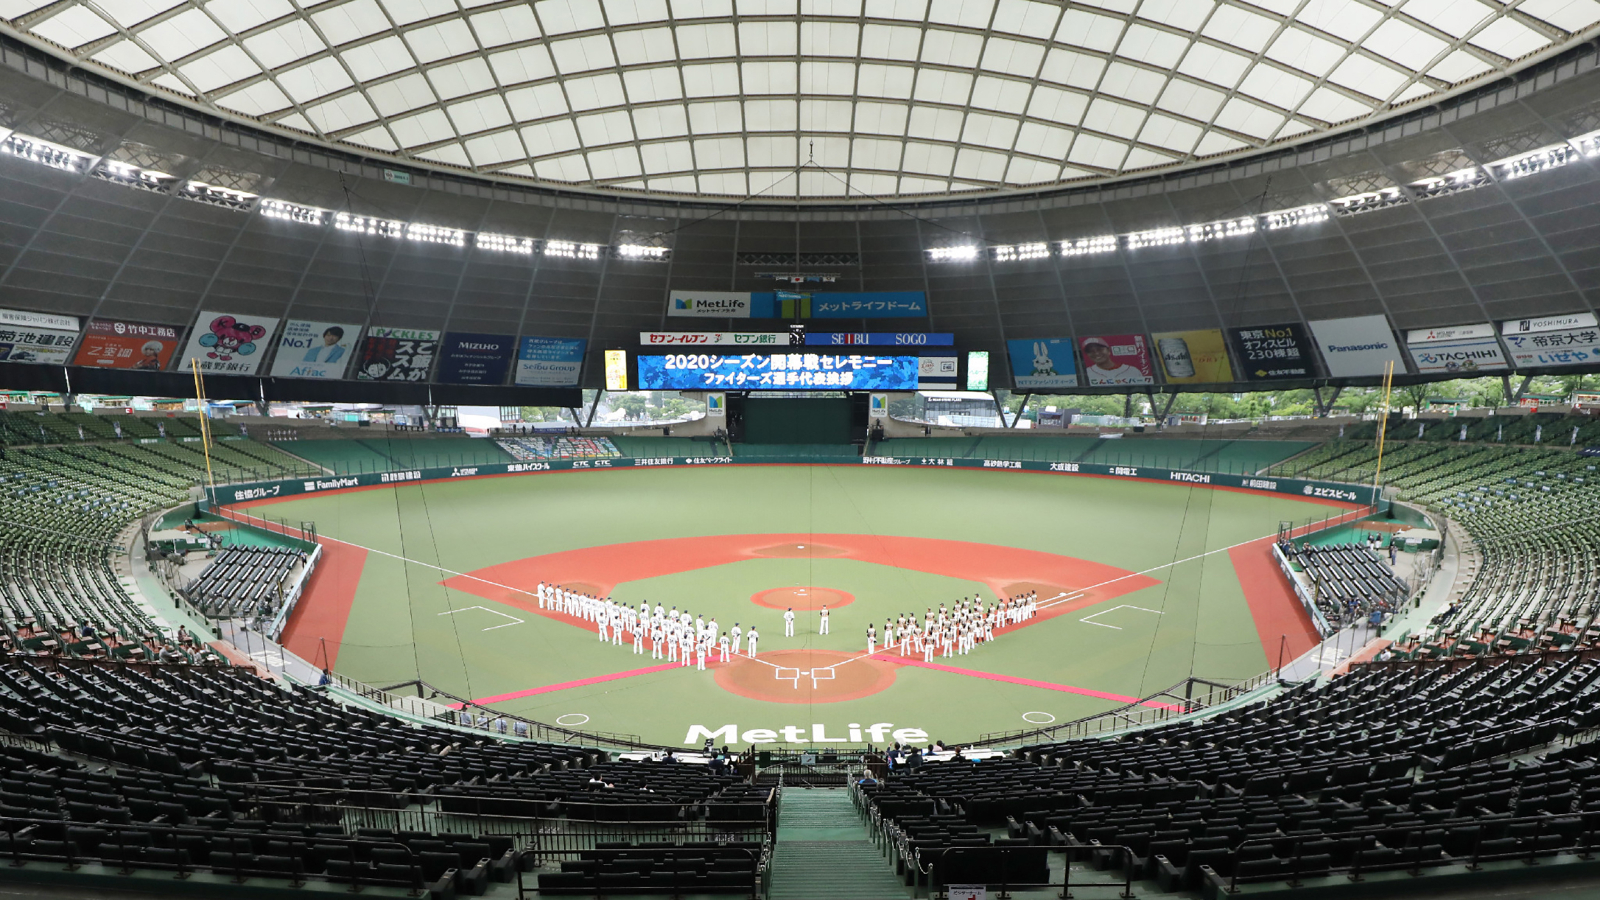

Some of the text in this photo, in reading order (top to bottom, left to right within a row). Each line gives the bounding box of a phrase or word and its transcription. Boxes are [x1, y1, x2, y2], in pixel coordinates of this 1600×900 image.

[696, 300, 745, 308] MetLife
[819, 301, 921, 311] メットライフドーム
[1533, 318, 1579, 327] YOSHIMURA
[128, 324, 175, 337] 竹中工務店
[282, 337, 313, 349] No.1
[734, 333, 776, 343] セブン銀行
[831, 333, 869, 345] SEIBU
[895, 333, 927, 345] SOGO
[1243, 338, 1296, 349] オフィスビル
[1531, 330, 1598, 347] 帝京大学
[458, 341, 499, 350] MIZUHO
[1328, 341, 1388, 352] Panasonic
[1247, 348, 1300, 360] 230棟超
[1436, 350, 1497, 360] TACHIHI
[1538, 351, 1589, 363] いせや
[187, 360, 251, 372] 武蔵野銀行
[387, 341, 415, 380] ススム
[665, 353, 893, 370] 2020シーズン開幕戦セレモニー
[289, 366, 327, 377] Aflac
[704, 372, 853, 385] ファイターズ選手代表挨拶
[634, 458, 673, 466] 三井住友銀行
[863, 457, 910, 465] 野村不動産グループ
[984, 460, 1021, 468] 高砂熱学工業
[1050, 462, 1079, 471] 大成建設
[507, 463, 550, 472] 東進ハイスクール
[1115, 467, 1137, 475] 関電工
[1170, 471, 1210, 483] HITACHI
[317, 477, 358, 490] FamilyMart
[1250, 479, 1277, 490] 前田建設
[235, 485, 280, 500] 住協グループ
[683, 723, 929, 745] MetLife
